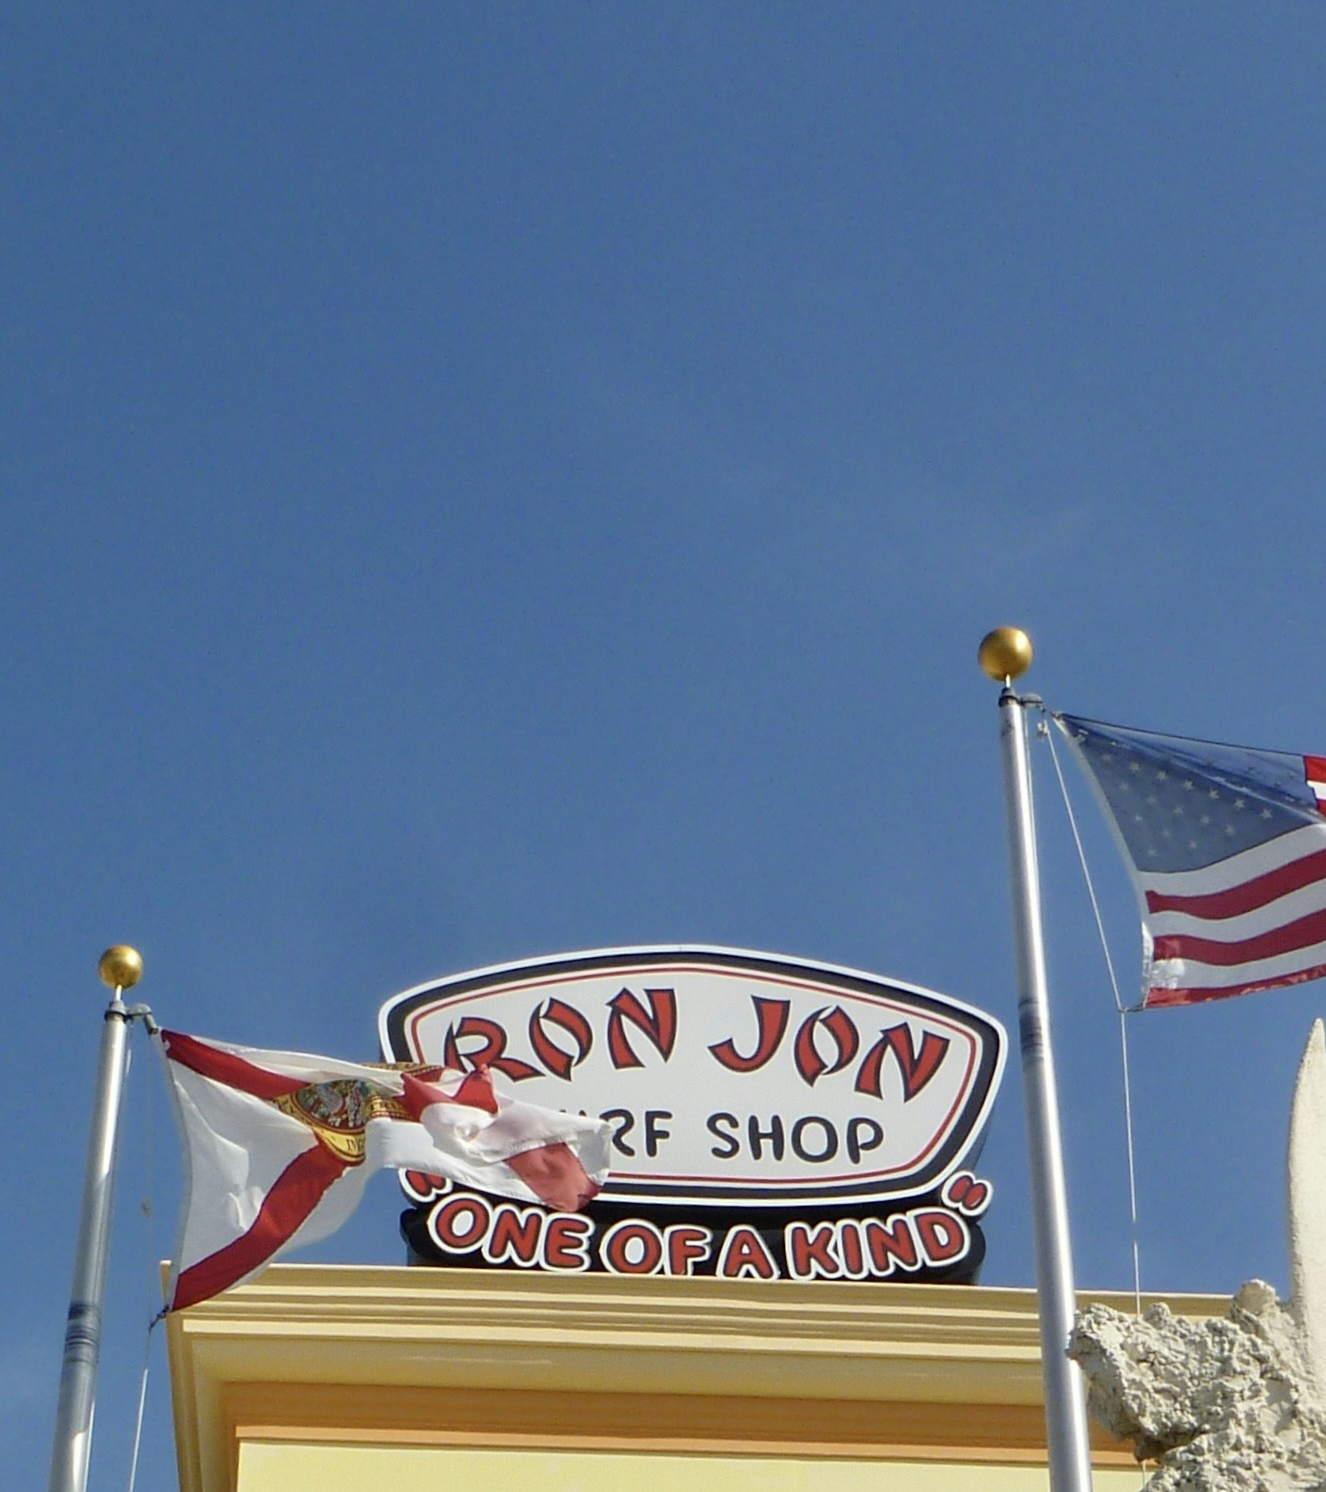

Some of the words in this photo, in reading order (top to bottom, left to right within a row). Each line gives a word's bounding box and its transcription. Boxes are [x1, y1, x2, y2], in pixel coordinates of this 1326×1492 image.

[443, 987, 678, 1082] RON
[707, 995, 951, 1103] JON
[559, 1108, 674, 1157] RF
[706, 1111, 885, 1165] SHOP
[603, 1222, 711, 1275] OF
[725, 1226, 778, 1280] A
